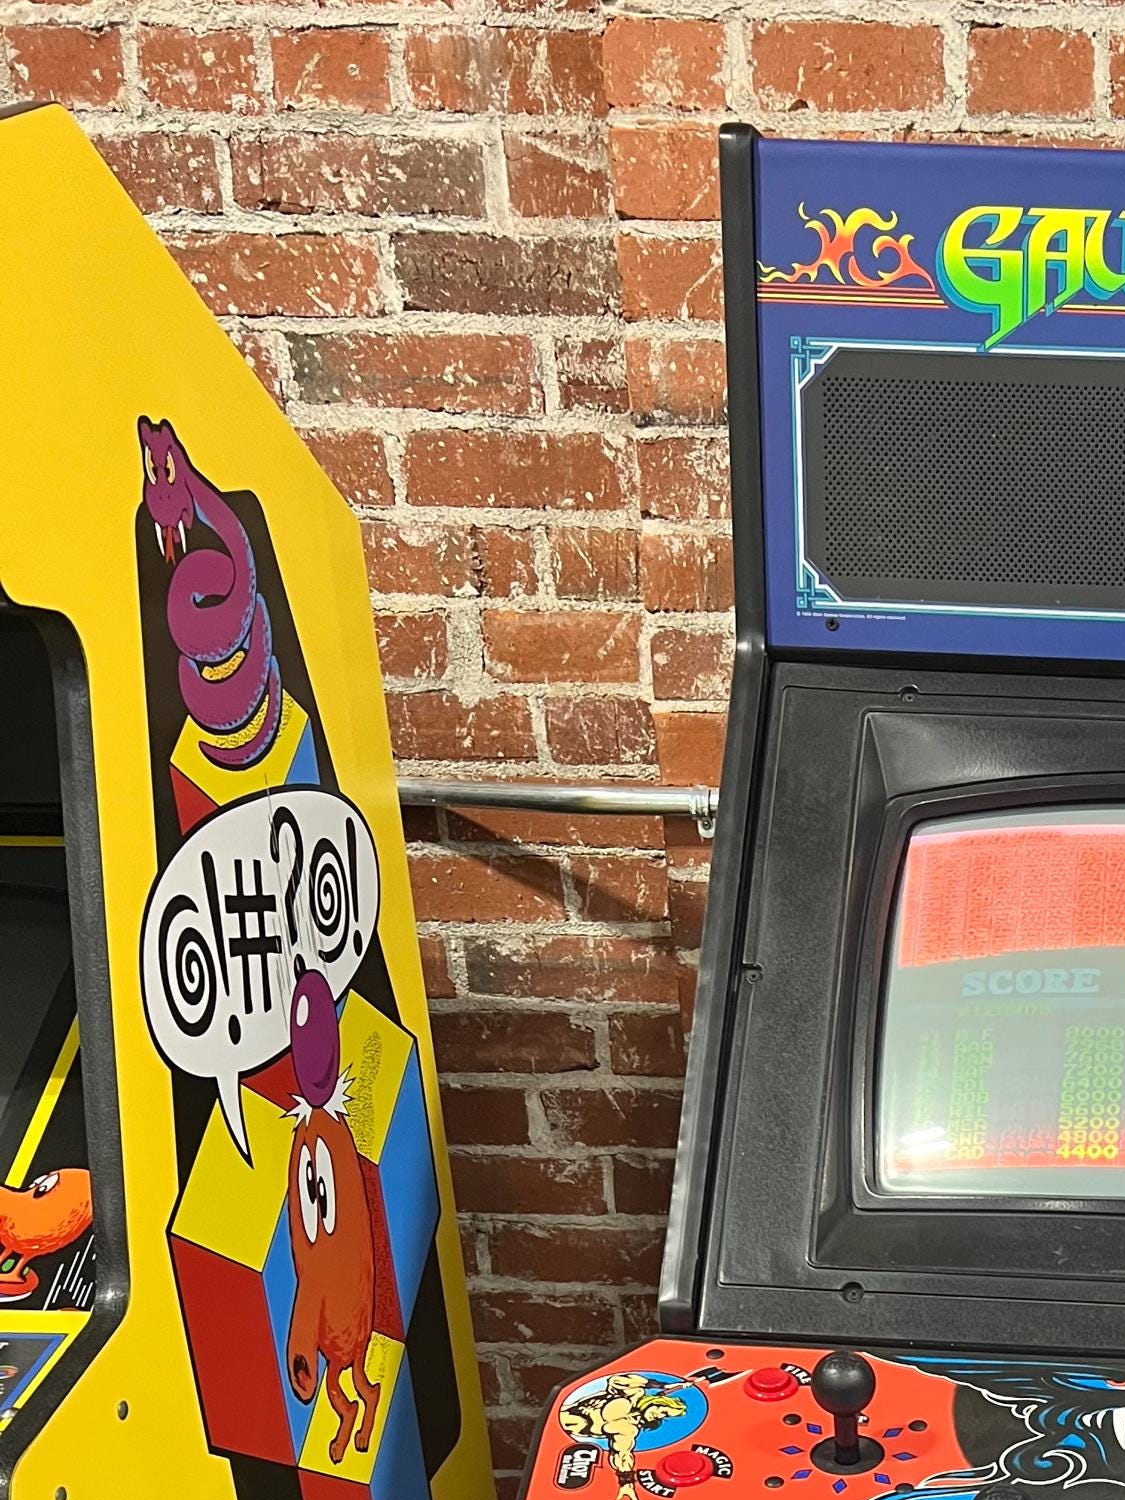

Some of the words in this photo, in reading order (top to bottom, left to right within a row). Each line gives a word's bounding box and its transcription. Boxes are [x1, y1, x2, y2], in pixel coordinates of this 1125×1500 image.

[961, 968, 1101, 997] SCORE
[1060, 1103, 1120, 1116] 5600
[1059, 1116, 1120, 1129] 5200
[1058, 1130, 1119, 1144] 4800
[1056, 1144, 1118, 1159] 4400
[784, 1364, 812, 1385] FIRE
[570, 1449, 598, 1479] Thor
[695, 1446, 731, 1476] MAGIC
[639, 1470, 675, 1497] START
